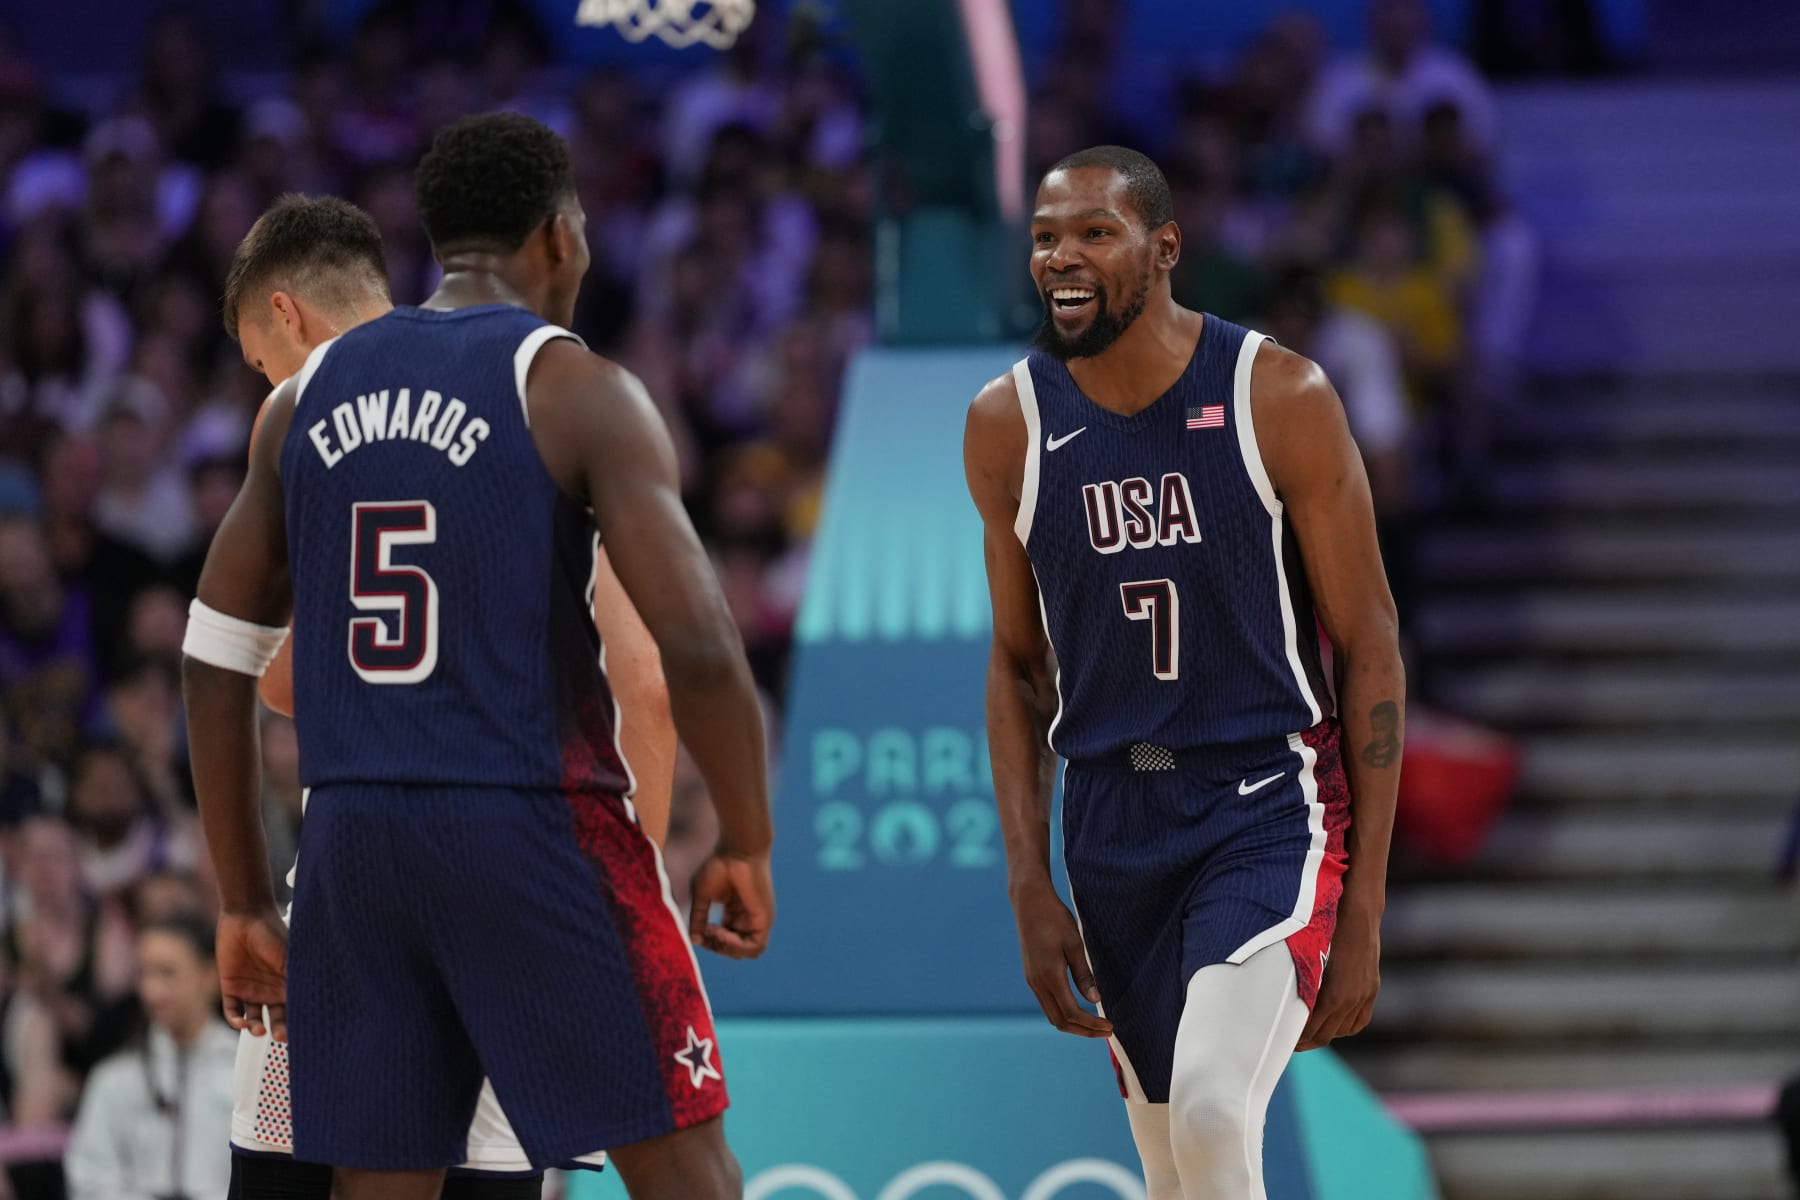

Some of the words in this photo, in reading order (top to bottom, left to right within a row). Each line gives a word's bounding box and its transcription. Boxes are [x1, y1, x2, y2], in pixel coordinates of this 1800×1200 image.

[308, 388, 490, 469] EDWARDS
[1082, 472, 1202, 554] USA
[348, 500, 439, 684] 5
[1119, 578, 1179, 681] 7
[814, 798, 1000, 868] 202
